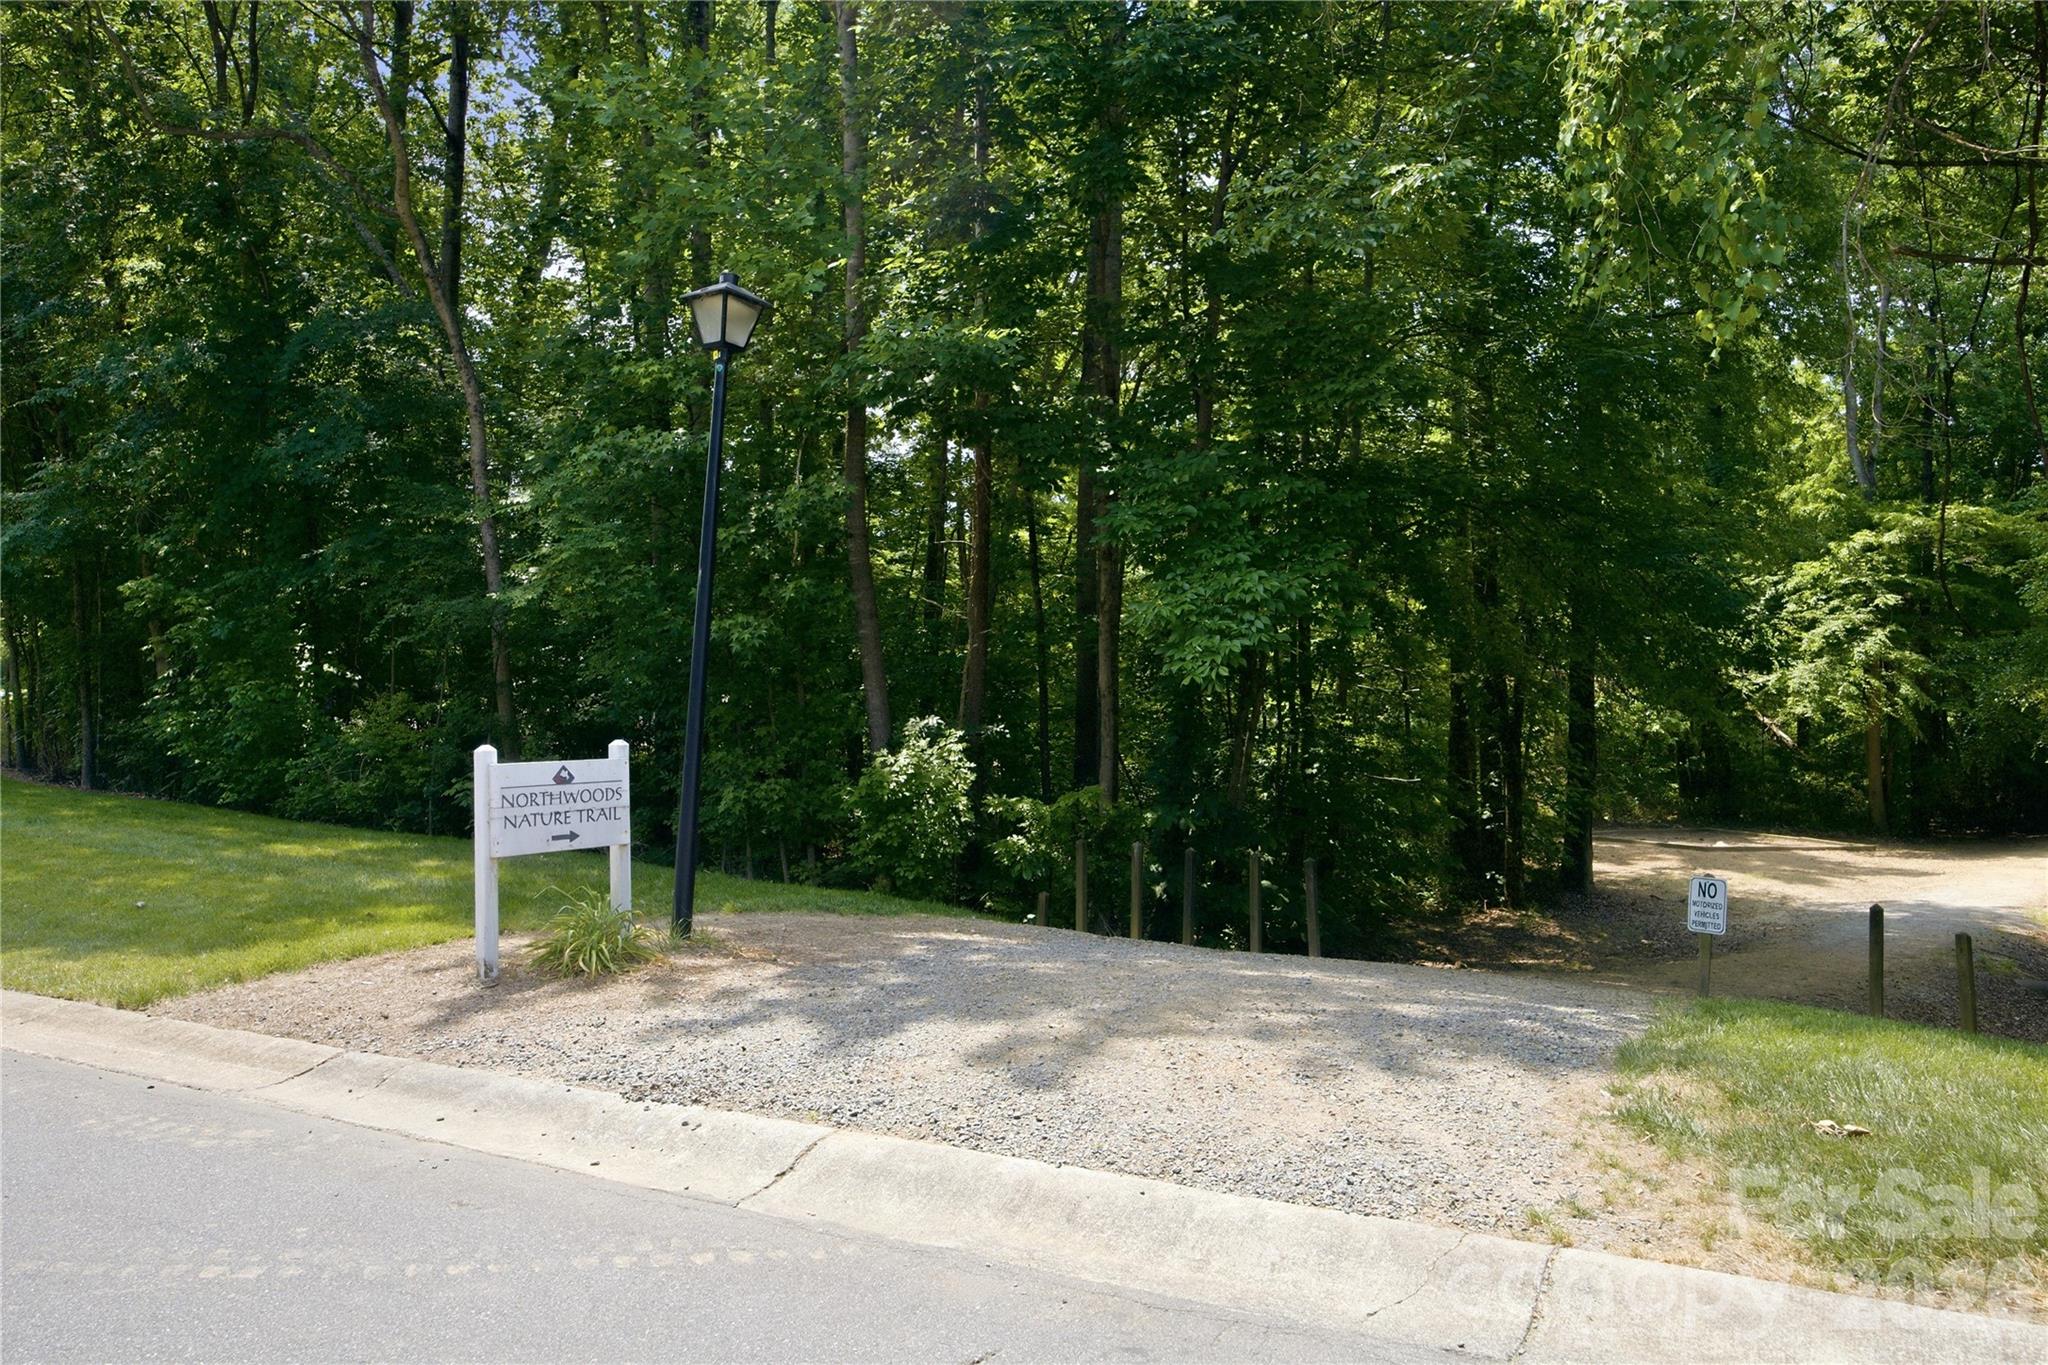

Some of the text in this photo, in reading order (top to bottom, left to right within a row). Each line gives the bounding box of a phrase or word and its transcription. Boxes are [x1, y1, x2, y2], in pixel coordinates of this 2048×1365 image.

[501, 787, 623, 809] NORTHWOODS
[503, 807, 622, 830] NATURE TRAIL
[1697, 881, 1718, 899] NO
[1691, 920, 1722, 930] PERMITTED
